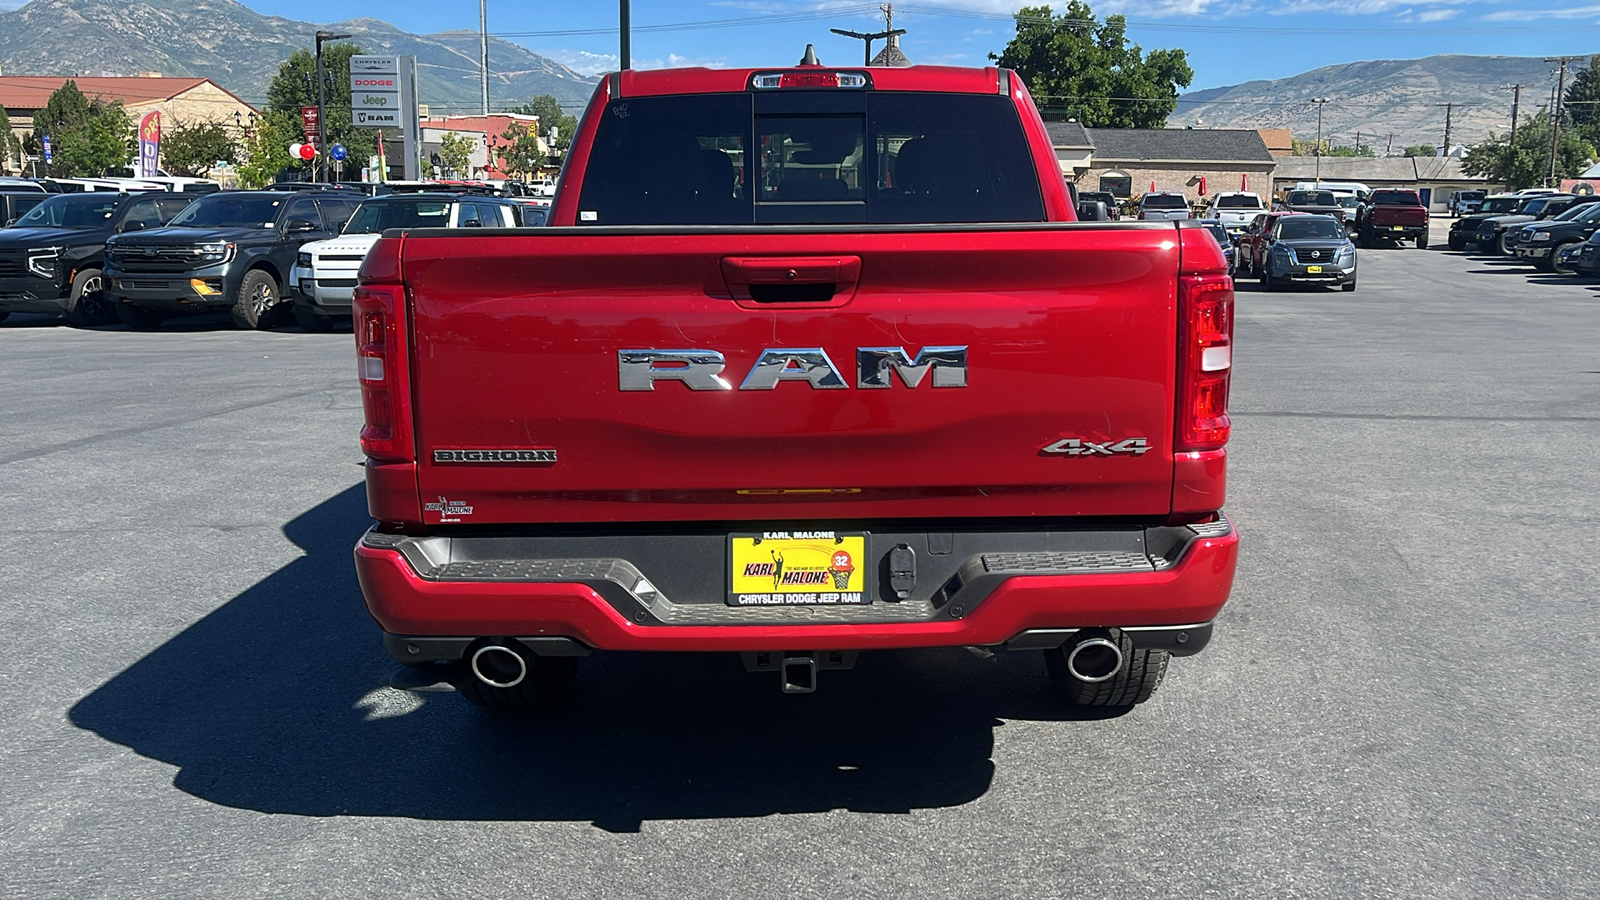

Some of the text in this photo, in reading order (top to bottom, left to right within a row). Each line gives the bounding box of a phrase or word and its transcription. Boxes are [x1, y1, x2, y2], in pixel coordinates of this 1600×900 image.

[362, 94, 387, 107] Jeep
[618, 346, 968, 391] RAM
[1042, 437, 1153, 455] 4x4
[434, 450, 557, 462] BIGHORN
[446, 506, 473, 515] MALONE
[793, 531, 835, 539] MALONE
[834, 556, 848, 567] 32
[743, 563, 775, 577] KARL
[780, 571, 830, 585] MALONE
[739, 593, 861, 604] CHRYSLER DODGE JEEP RAM
